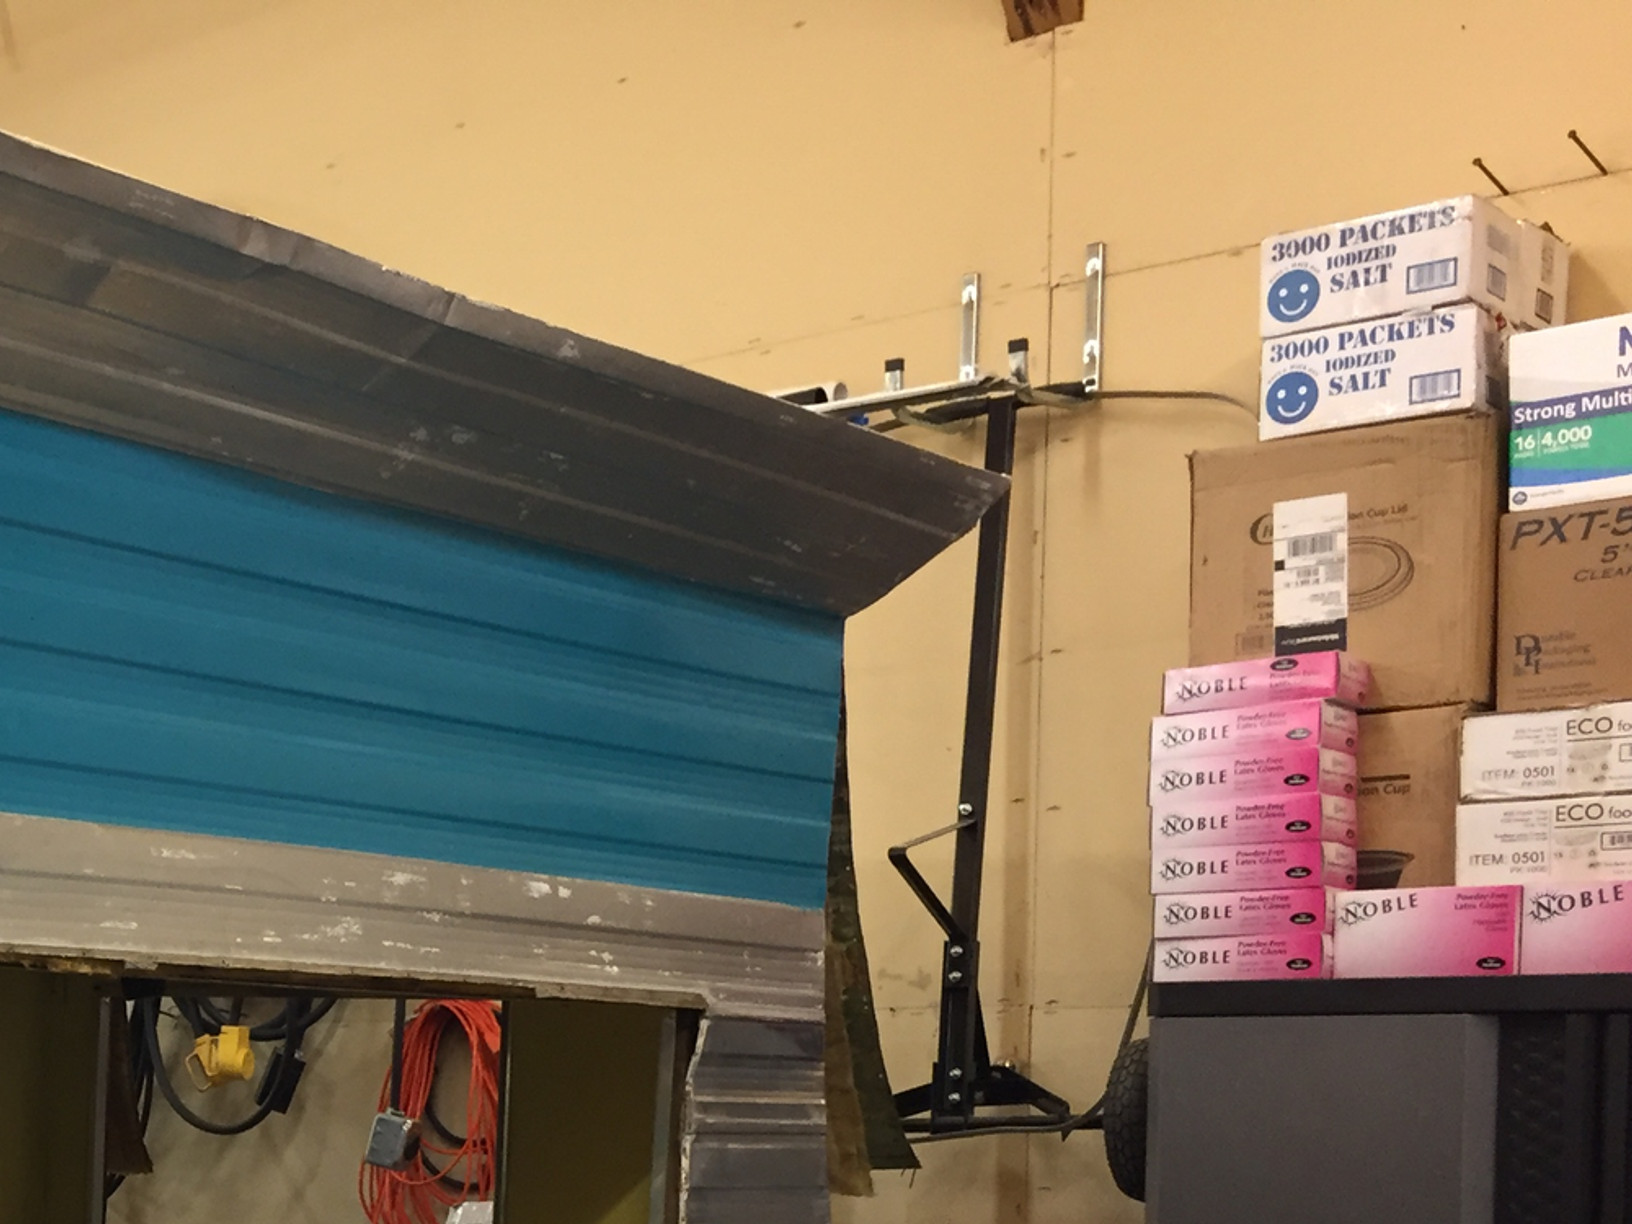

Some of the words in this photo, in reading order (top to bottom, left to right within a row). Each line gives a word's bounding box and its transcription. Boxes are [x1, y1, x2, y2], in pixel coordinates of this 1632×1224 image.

[1271, 233, 1330, 262] 3000
[1338, 206, 1456, 248] PACKETS
[1326, 244, 1397, 270] IODIZED
[1330, 263, 1392, 293] SALT
[1270, 336, 1329, 363] 3000
[1338, 314, 1456, 351] PACKETS
[1325, 349, 1396, 373] IODIZED
[1329, 368, 1391, 396] SALT
[1514, 402, 1576, 424] Strong
[1514, 434, 1536, 451] 16
[1541, 425, 1593, 448] 4,000
[1178, 675, 1248, 700] NOBLE
[1165, 725, 1229, 745] NOBLE
[1566, 716, 1614, 736] ECO
[1162, 770, 1227, 789] NOBLE
[1522, 765, 1555, 779] 0501
[1383, 783, 1411, 796] Cup
[1555, 802, 1604, 822] ECO
[1165, 815, 1229, 834] NOBLE
[1511, 851, 1545, 865] 0501
[1164, 860, 1229, 878] NOBLE
[1343, 892, 1418, 923] NOBLE
[1534, 884, 1625, 919] NOBLE
[1168, 905, 1233, 923] NOBLE
[1167, 950, 1231, 968] NOBLE
